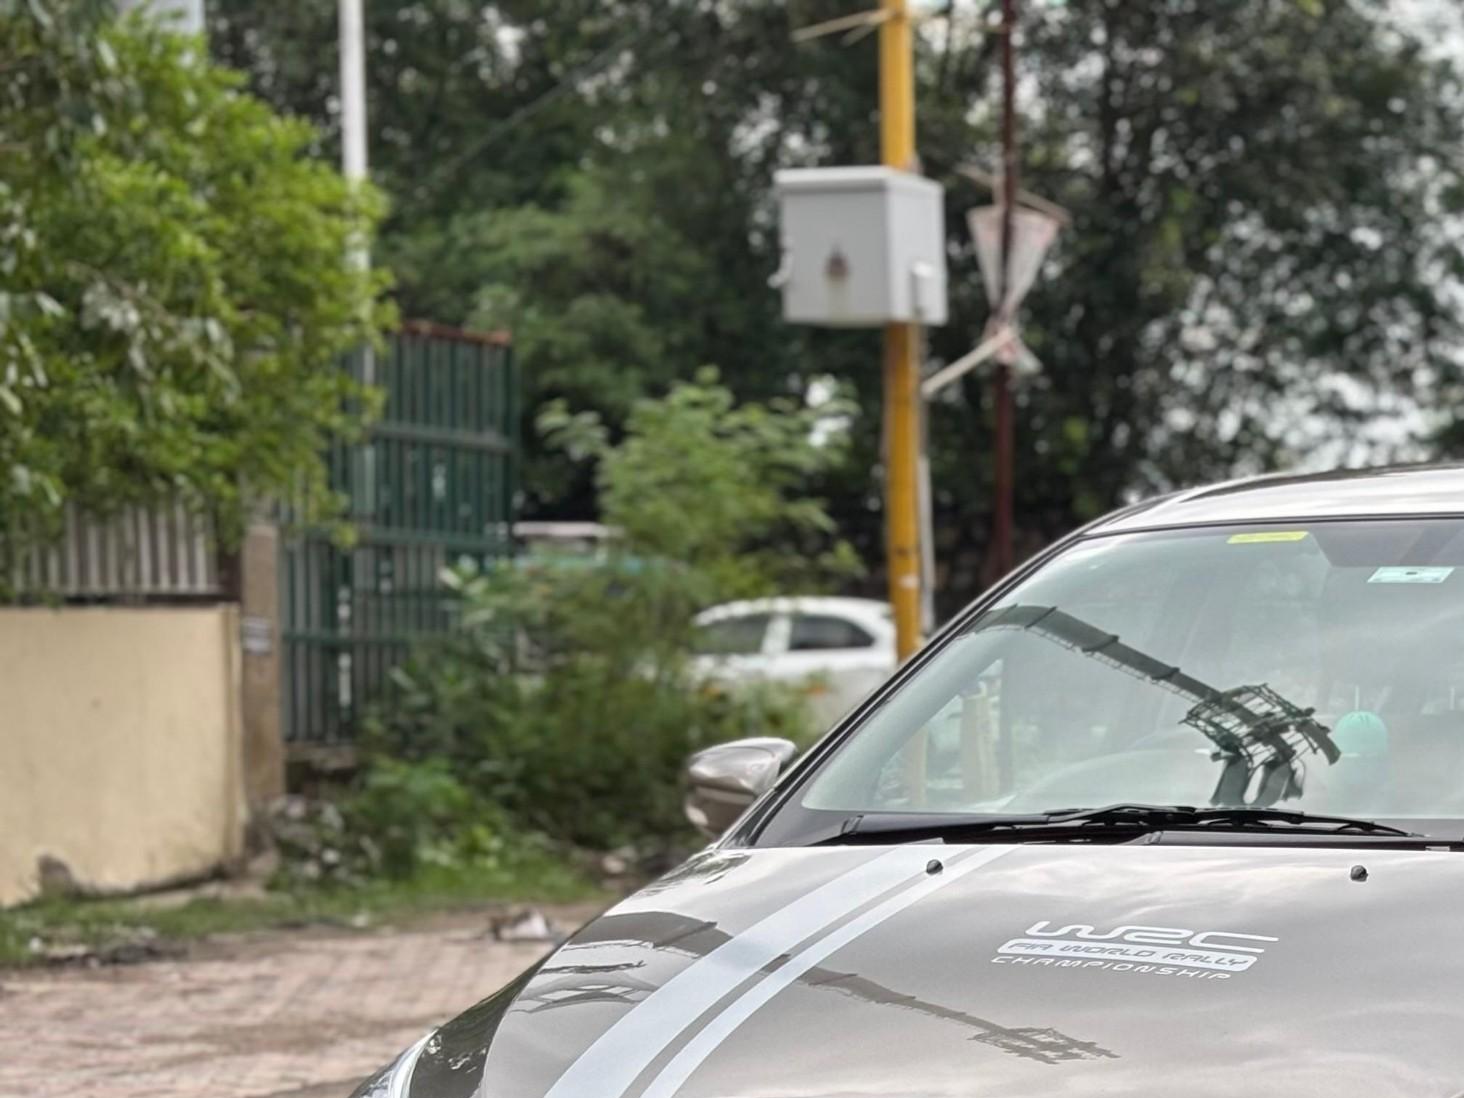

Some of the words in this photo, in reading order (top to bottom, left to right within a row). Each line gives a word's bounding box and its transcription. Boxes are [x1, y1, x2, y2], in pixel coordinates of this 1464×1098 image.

[1025, 921, 1280, 954] WRC
[990, 955, 1232, 980] CHAMPIONSHIP
[1059, 944, 1157, 958] WORLD
[1162, 953, 1249, 966] RALLY
